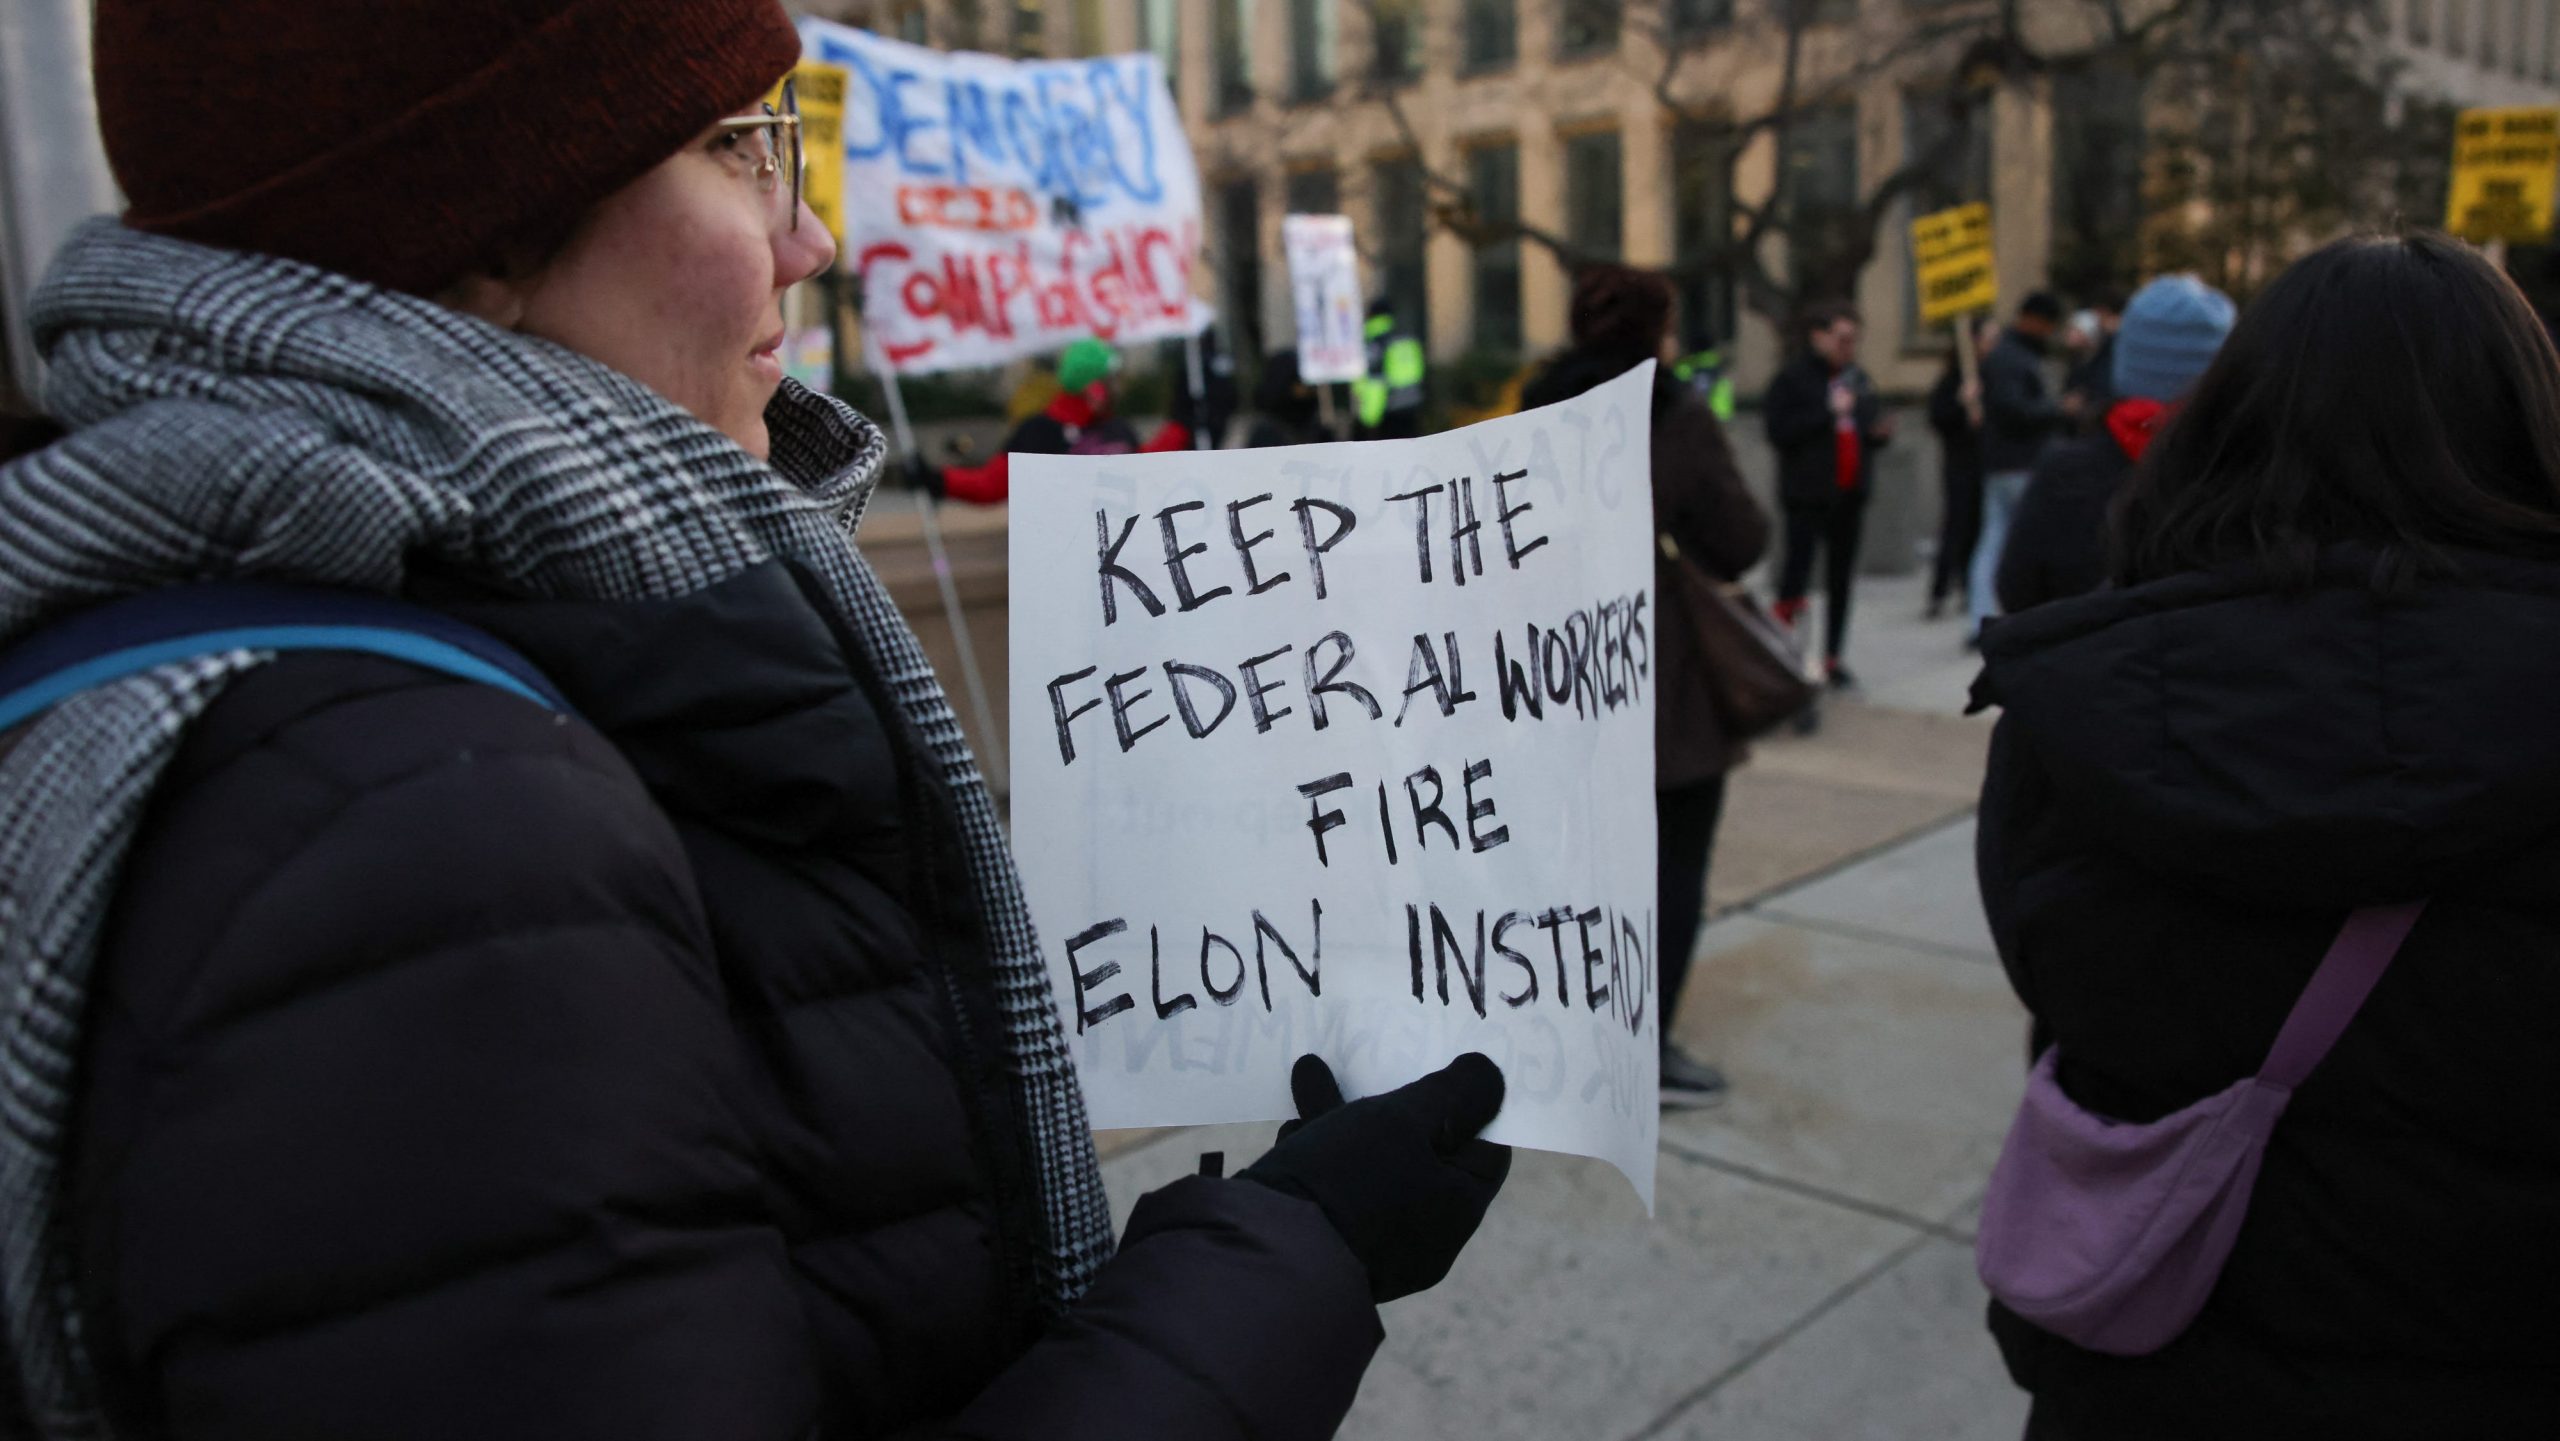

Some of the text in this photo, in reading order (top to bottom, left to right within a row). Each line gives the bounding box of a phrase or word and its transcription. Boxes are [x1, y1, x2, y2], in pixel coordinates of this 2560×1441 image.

[1097, 469, 1548, 627] KEEP THE
[1047, 590, 1647, 766] FEDERAL WORKERS
[1296, 759, 1509, 868] FIRE
[1064, 898, 1653, 1037] ELON INSTEAD!
